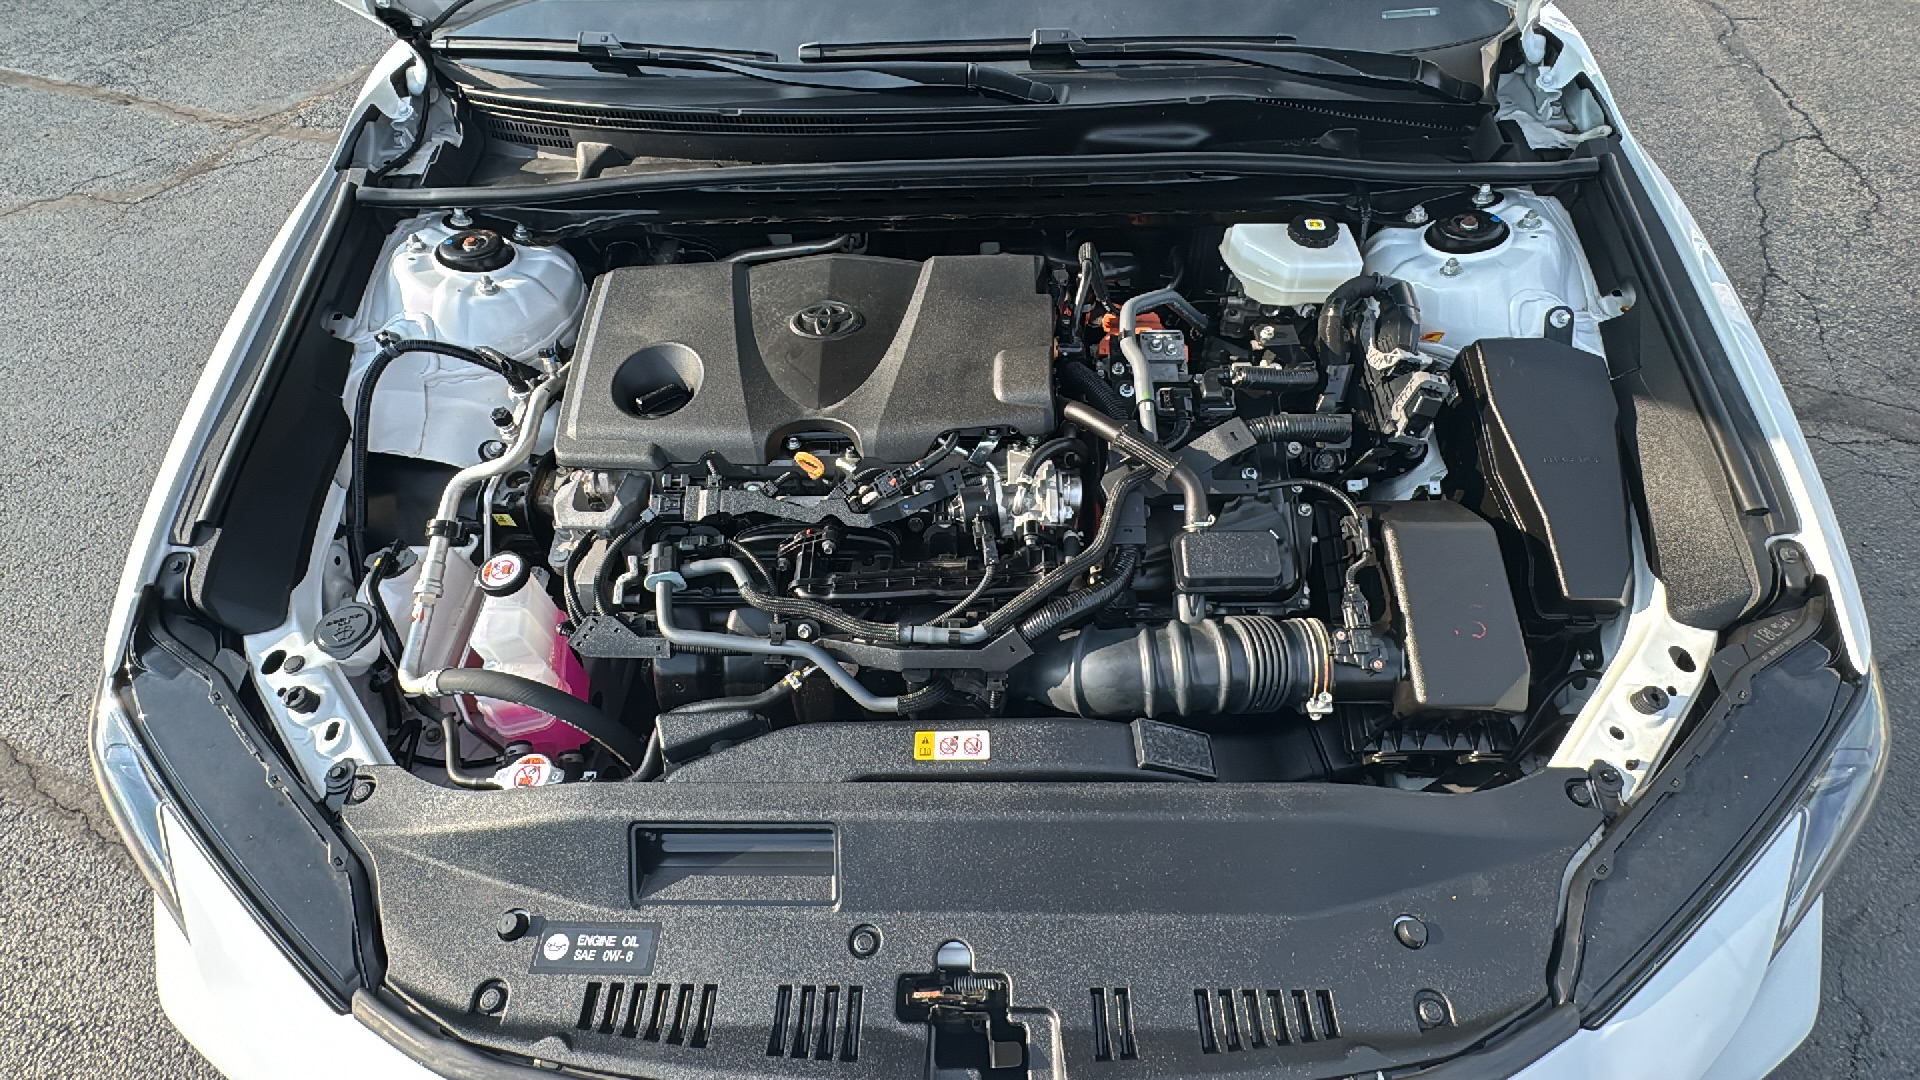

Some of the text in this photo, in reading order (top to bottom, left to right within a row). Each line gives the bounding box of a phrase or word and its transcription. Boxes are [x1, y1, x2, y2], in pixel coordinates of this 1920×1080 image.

[577, 934, 640, 948] ENGINE OIL
[573, 949, 634, 963] SAE 0W-8
